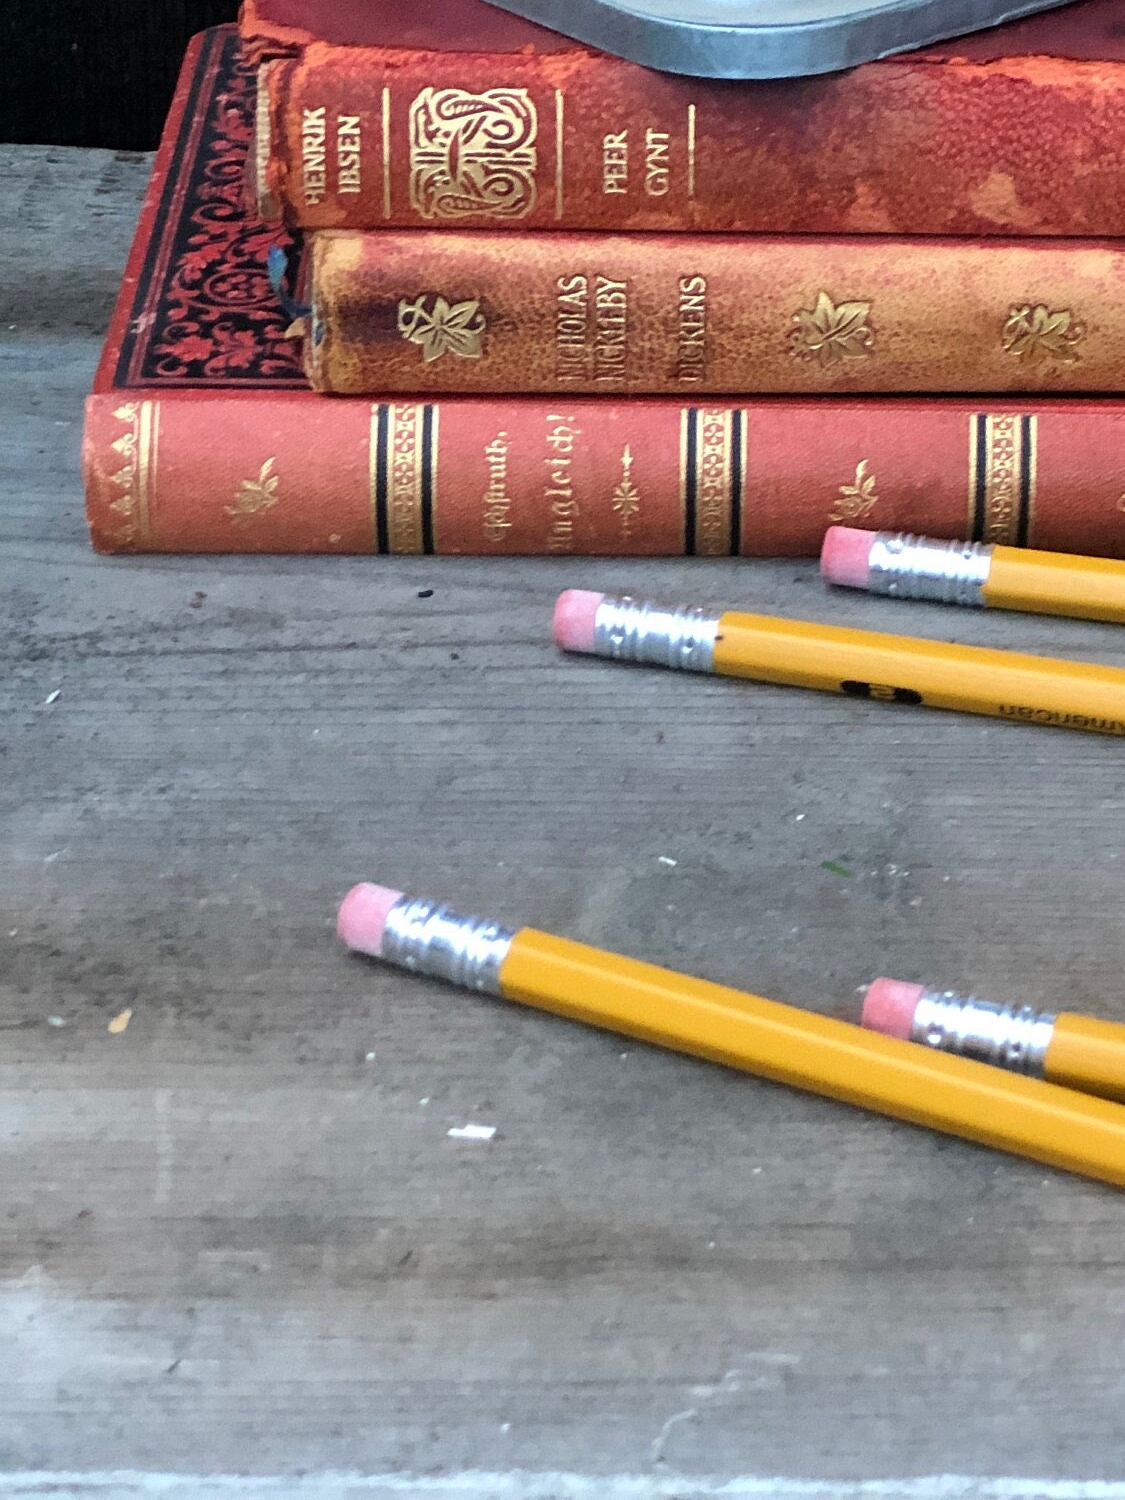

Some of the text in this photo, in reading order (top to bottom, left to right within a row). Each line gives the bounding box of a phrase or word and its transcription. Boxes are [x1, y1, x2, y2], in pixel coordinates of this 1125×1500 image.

[300, 106, 327, 206] HENRIK
[336, 114, 362, 195] IBSEN
[601, 129, 629, 195] PEER
[643, 126, 670, 197] GYNT
[556, 274, 588, 383] NICHOLAS
[594, 275, 628, 383] NICKLEBY
[678, 275, 708, 383] DICKENS
